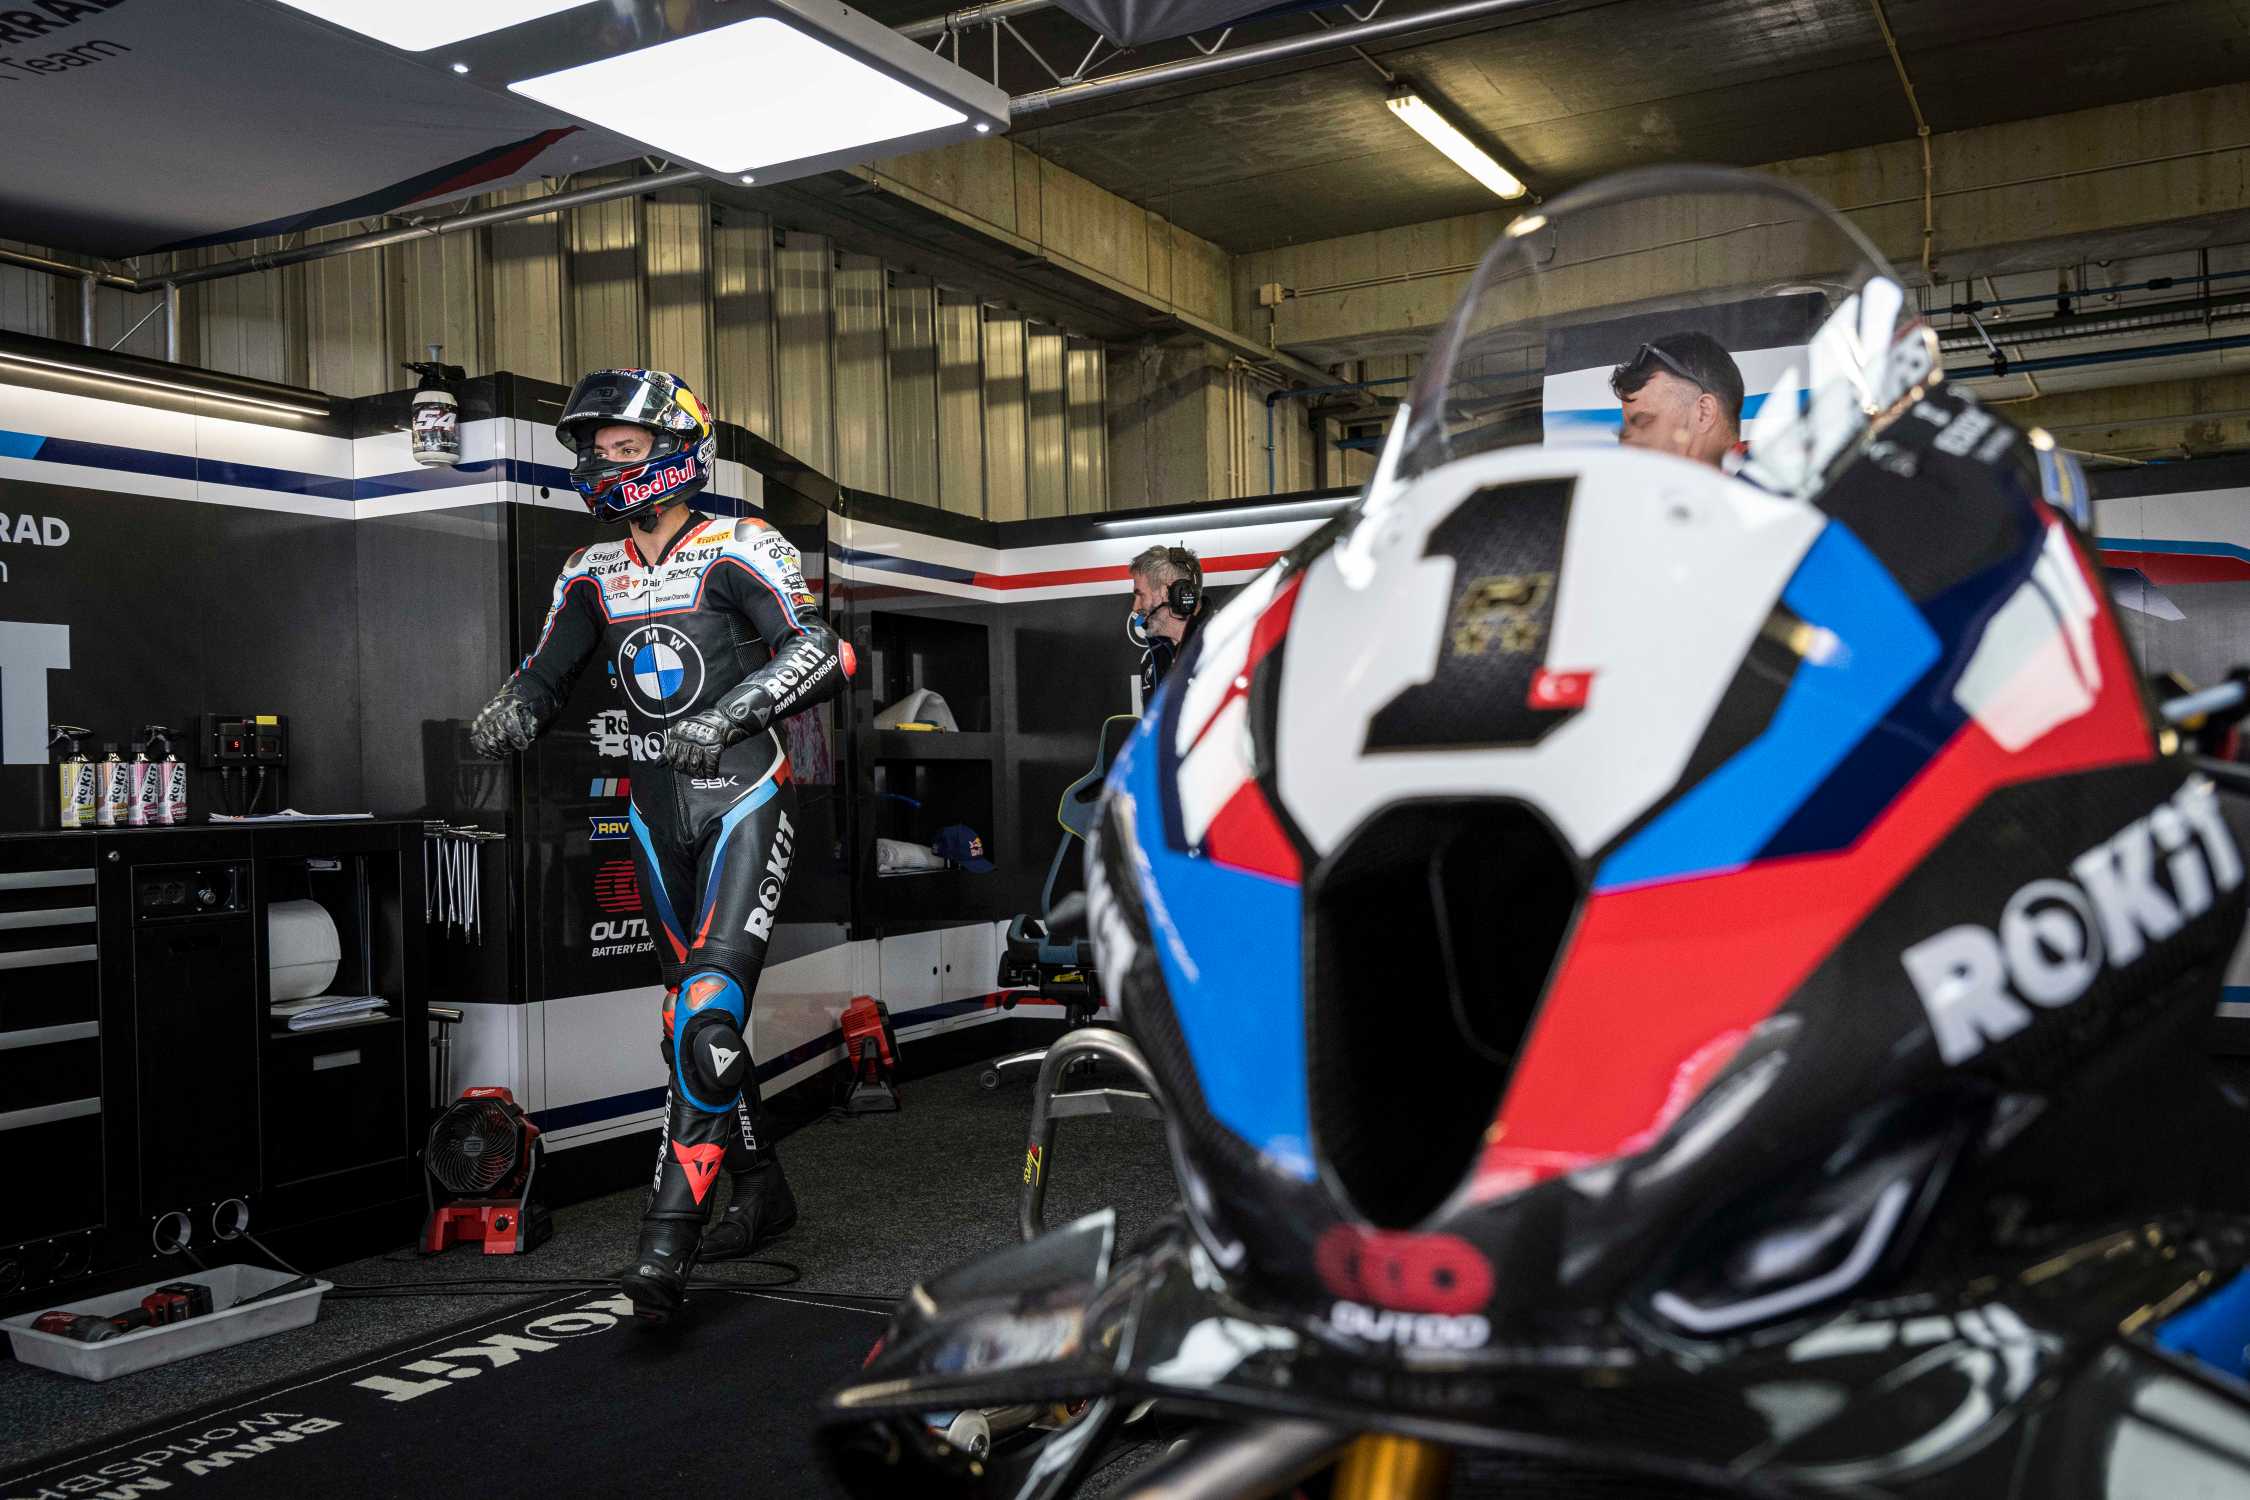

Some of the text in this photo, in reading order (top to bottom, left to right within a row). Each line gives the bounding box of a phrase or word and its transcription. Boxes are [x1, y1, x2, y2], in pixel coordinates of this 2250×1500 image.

[622, 456, 697, 506] Red Bull
[1361, 474, 1586, 758] 1
[623, 628, 687, 660] BMW
[774, 654, 838, 715] BMW MOTORRAD
[691, 775, 740, 789] SBK
[591, 943, 637, 957] BATTERY
[183, 1416, 344, 1476] BMW
